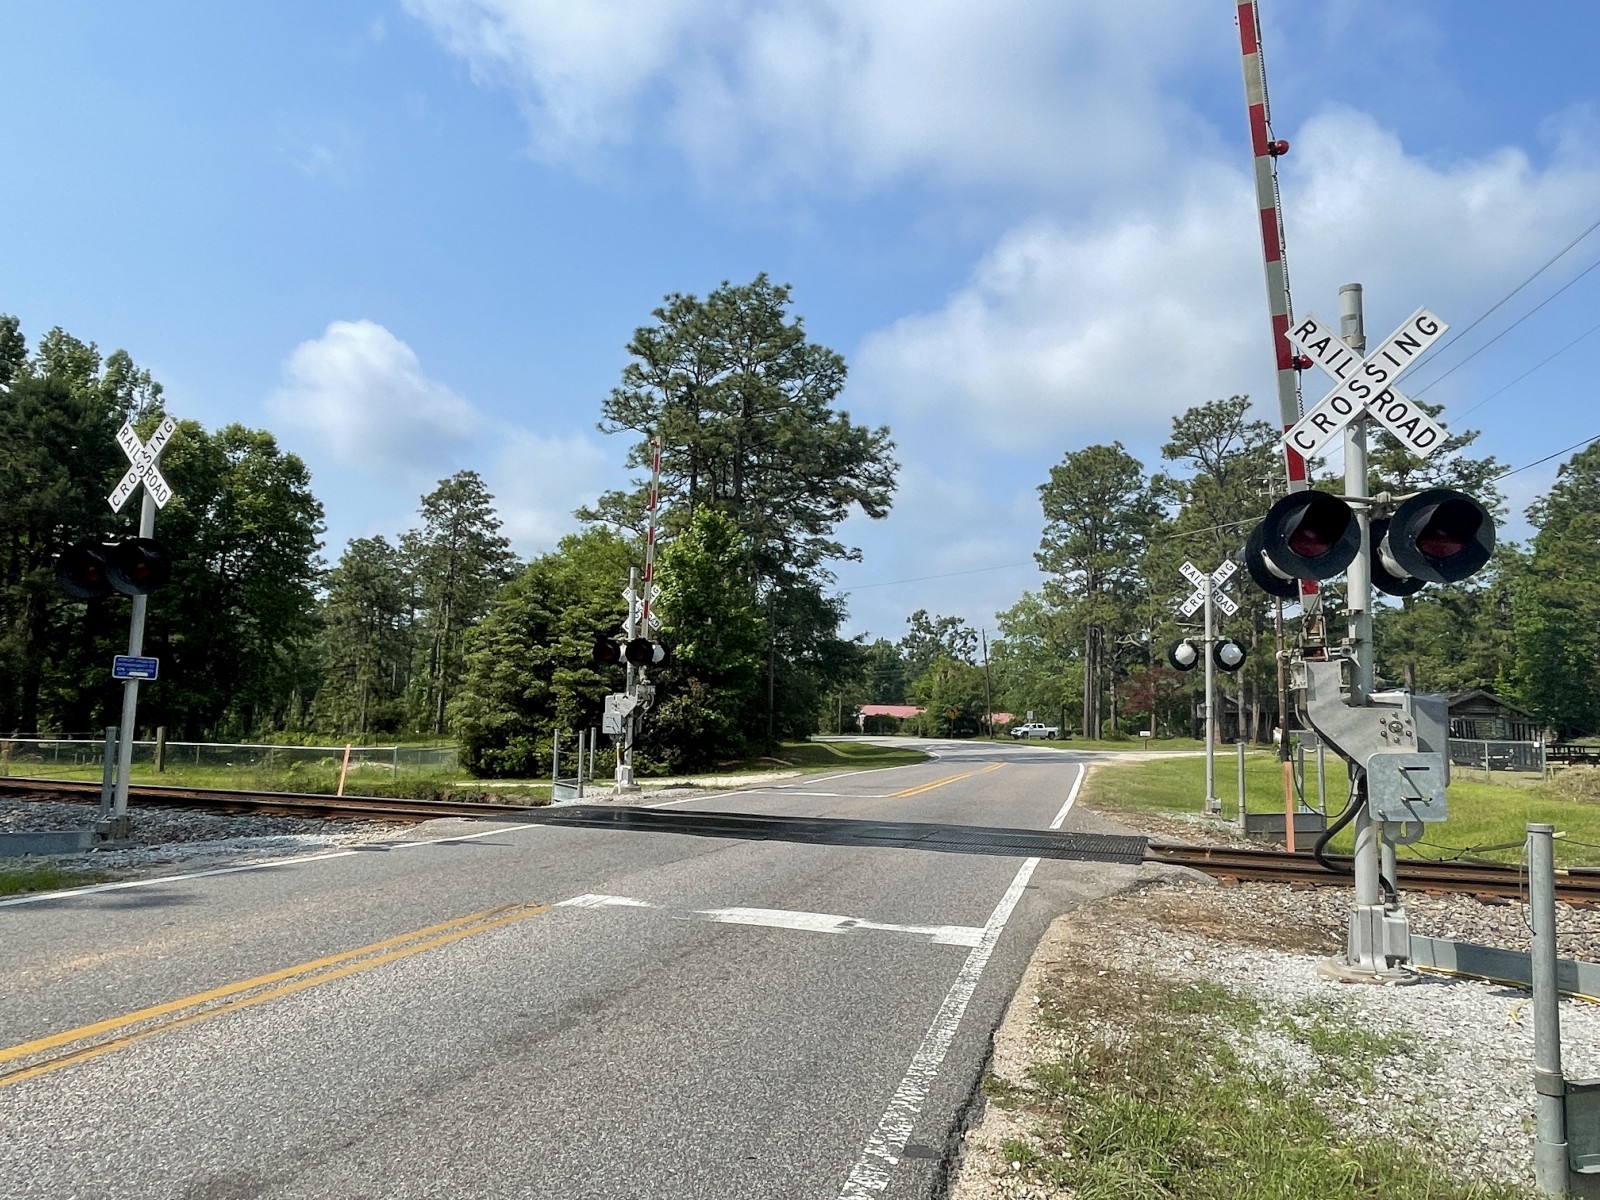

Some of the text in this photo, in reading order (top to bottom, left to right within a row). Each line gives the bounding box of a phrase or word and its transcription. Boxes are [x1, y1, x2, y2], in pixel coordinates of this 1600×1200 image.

[1293, 316, 1439, 450] CROSSING
[1293, 319, 1437, 449] RAIL ROAD
[112, 421, 173, 507] CROSSING
[1183, 563, 1234, 614] CROING
